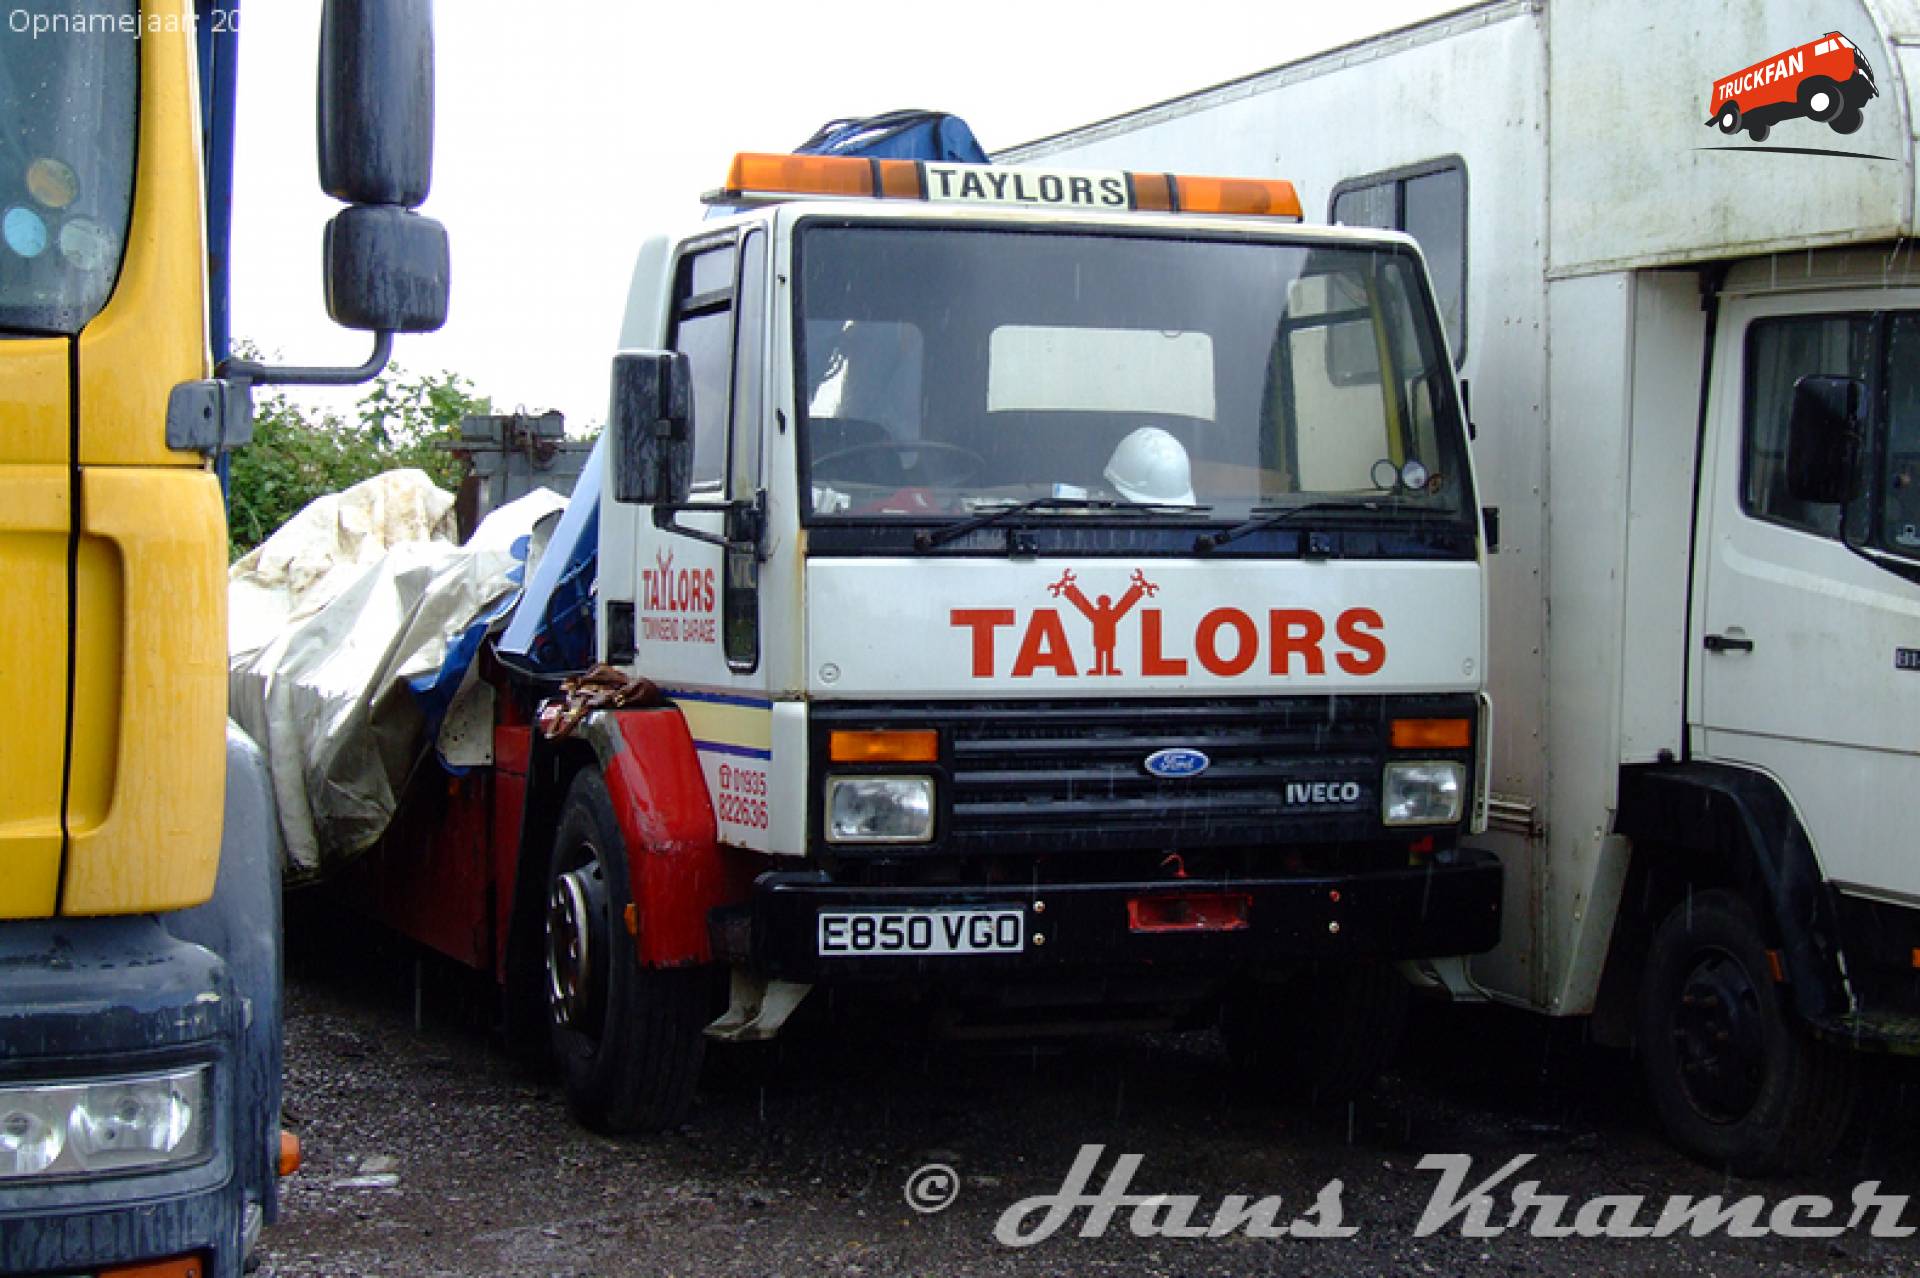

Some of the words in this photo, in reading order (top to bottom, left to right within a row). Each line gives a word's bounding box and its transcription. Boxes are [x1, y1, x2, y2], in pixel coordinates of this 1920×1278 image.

[930, 168, 1126, 206] TAYLORS
[641, 546, 716, 613] TAYLORS
[949, 568, 1387, 678] TAYLORS
[1159, 753, 1194, 771] Ford
[1286, 781, 1361, 804] IVECO
[823, 915, 932, 951] E850
[942, 914, 1020, 950] VGO
